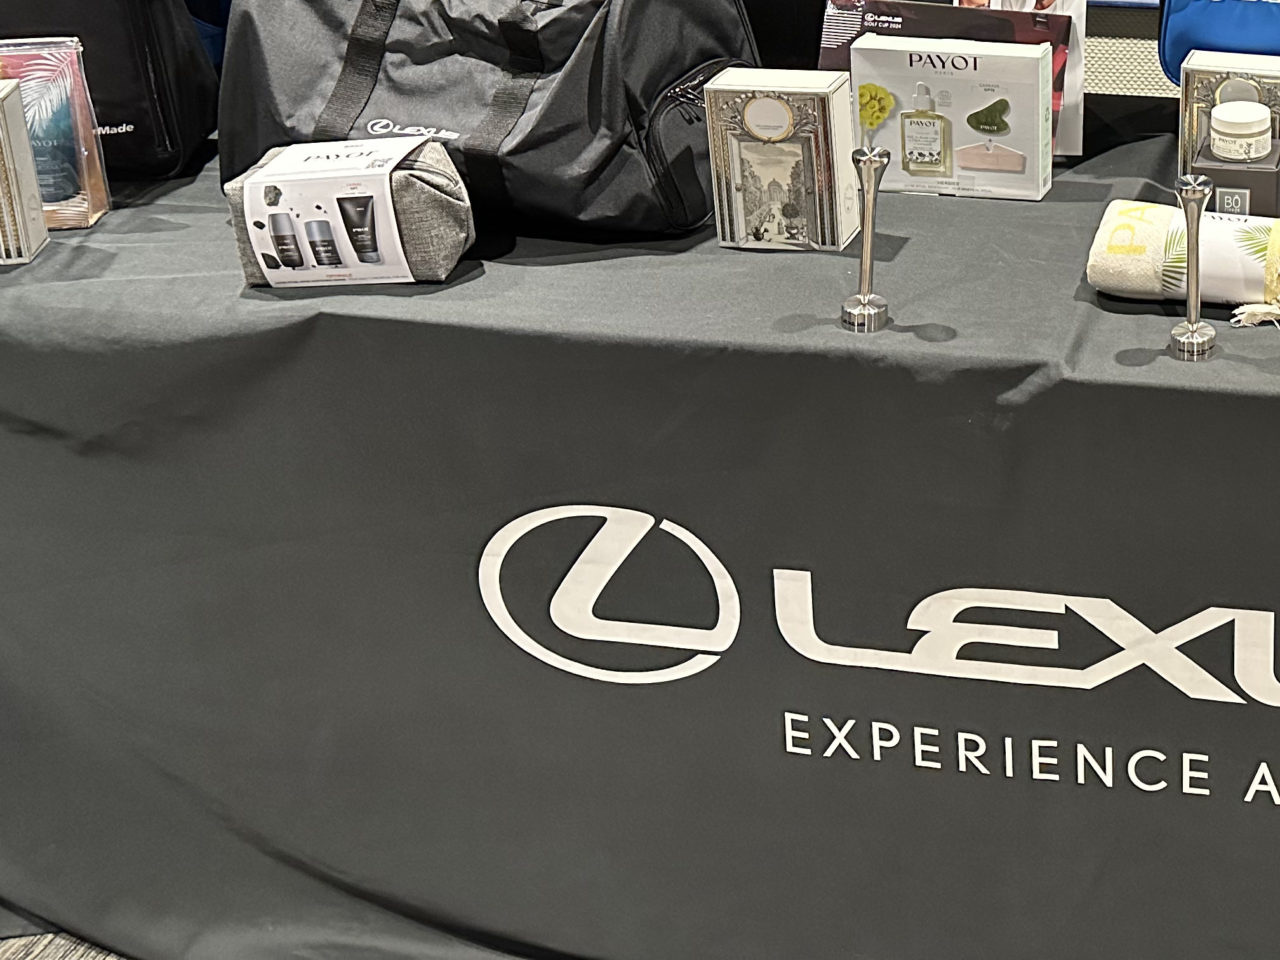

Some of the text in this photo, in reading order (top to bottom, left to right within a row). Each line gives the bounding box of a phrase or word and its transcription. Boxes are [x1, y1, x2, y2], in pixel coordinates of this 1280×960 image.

[908, 52, 983, 71] PAYOT
[393, 125, 460, 140] LEXUS
[304, 150, 378, 162] PAYOT
[1224, 194, 1241, 208] BÔ
[784, 711, 1211, 796] EXPERIENCE
